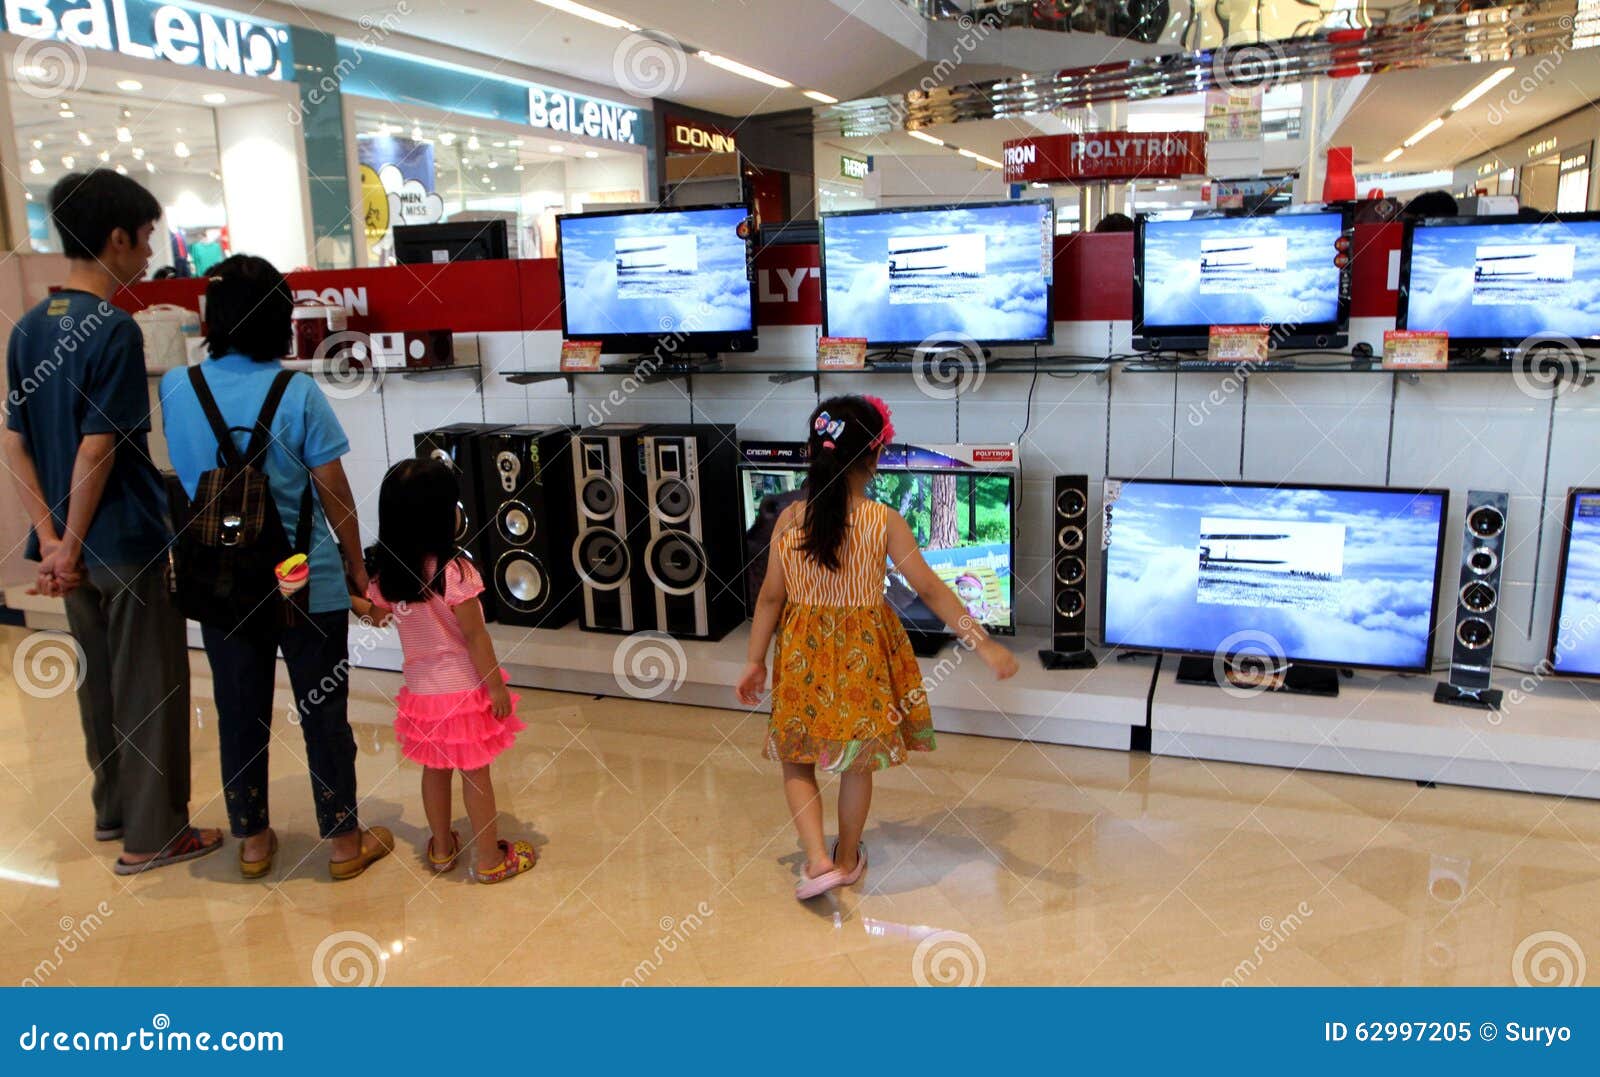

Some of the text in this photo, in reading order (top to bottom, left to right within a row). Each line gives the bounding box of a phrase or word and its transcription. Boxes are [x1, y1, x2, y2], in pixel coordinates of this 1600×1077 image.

[676, 125, 735, 153] DONINI
[1070, 138, 1188, 160] POLYTRON
[401, 192, 421, 203] MEN
[406, 205, 426, 216] MISS
